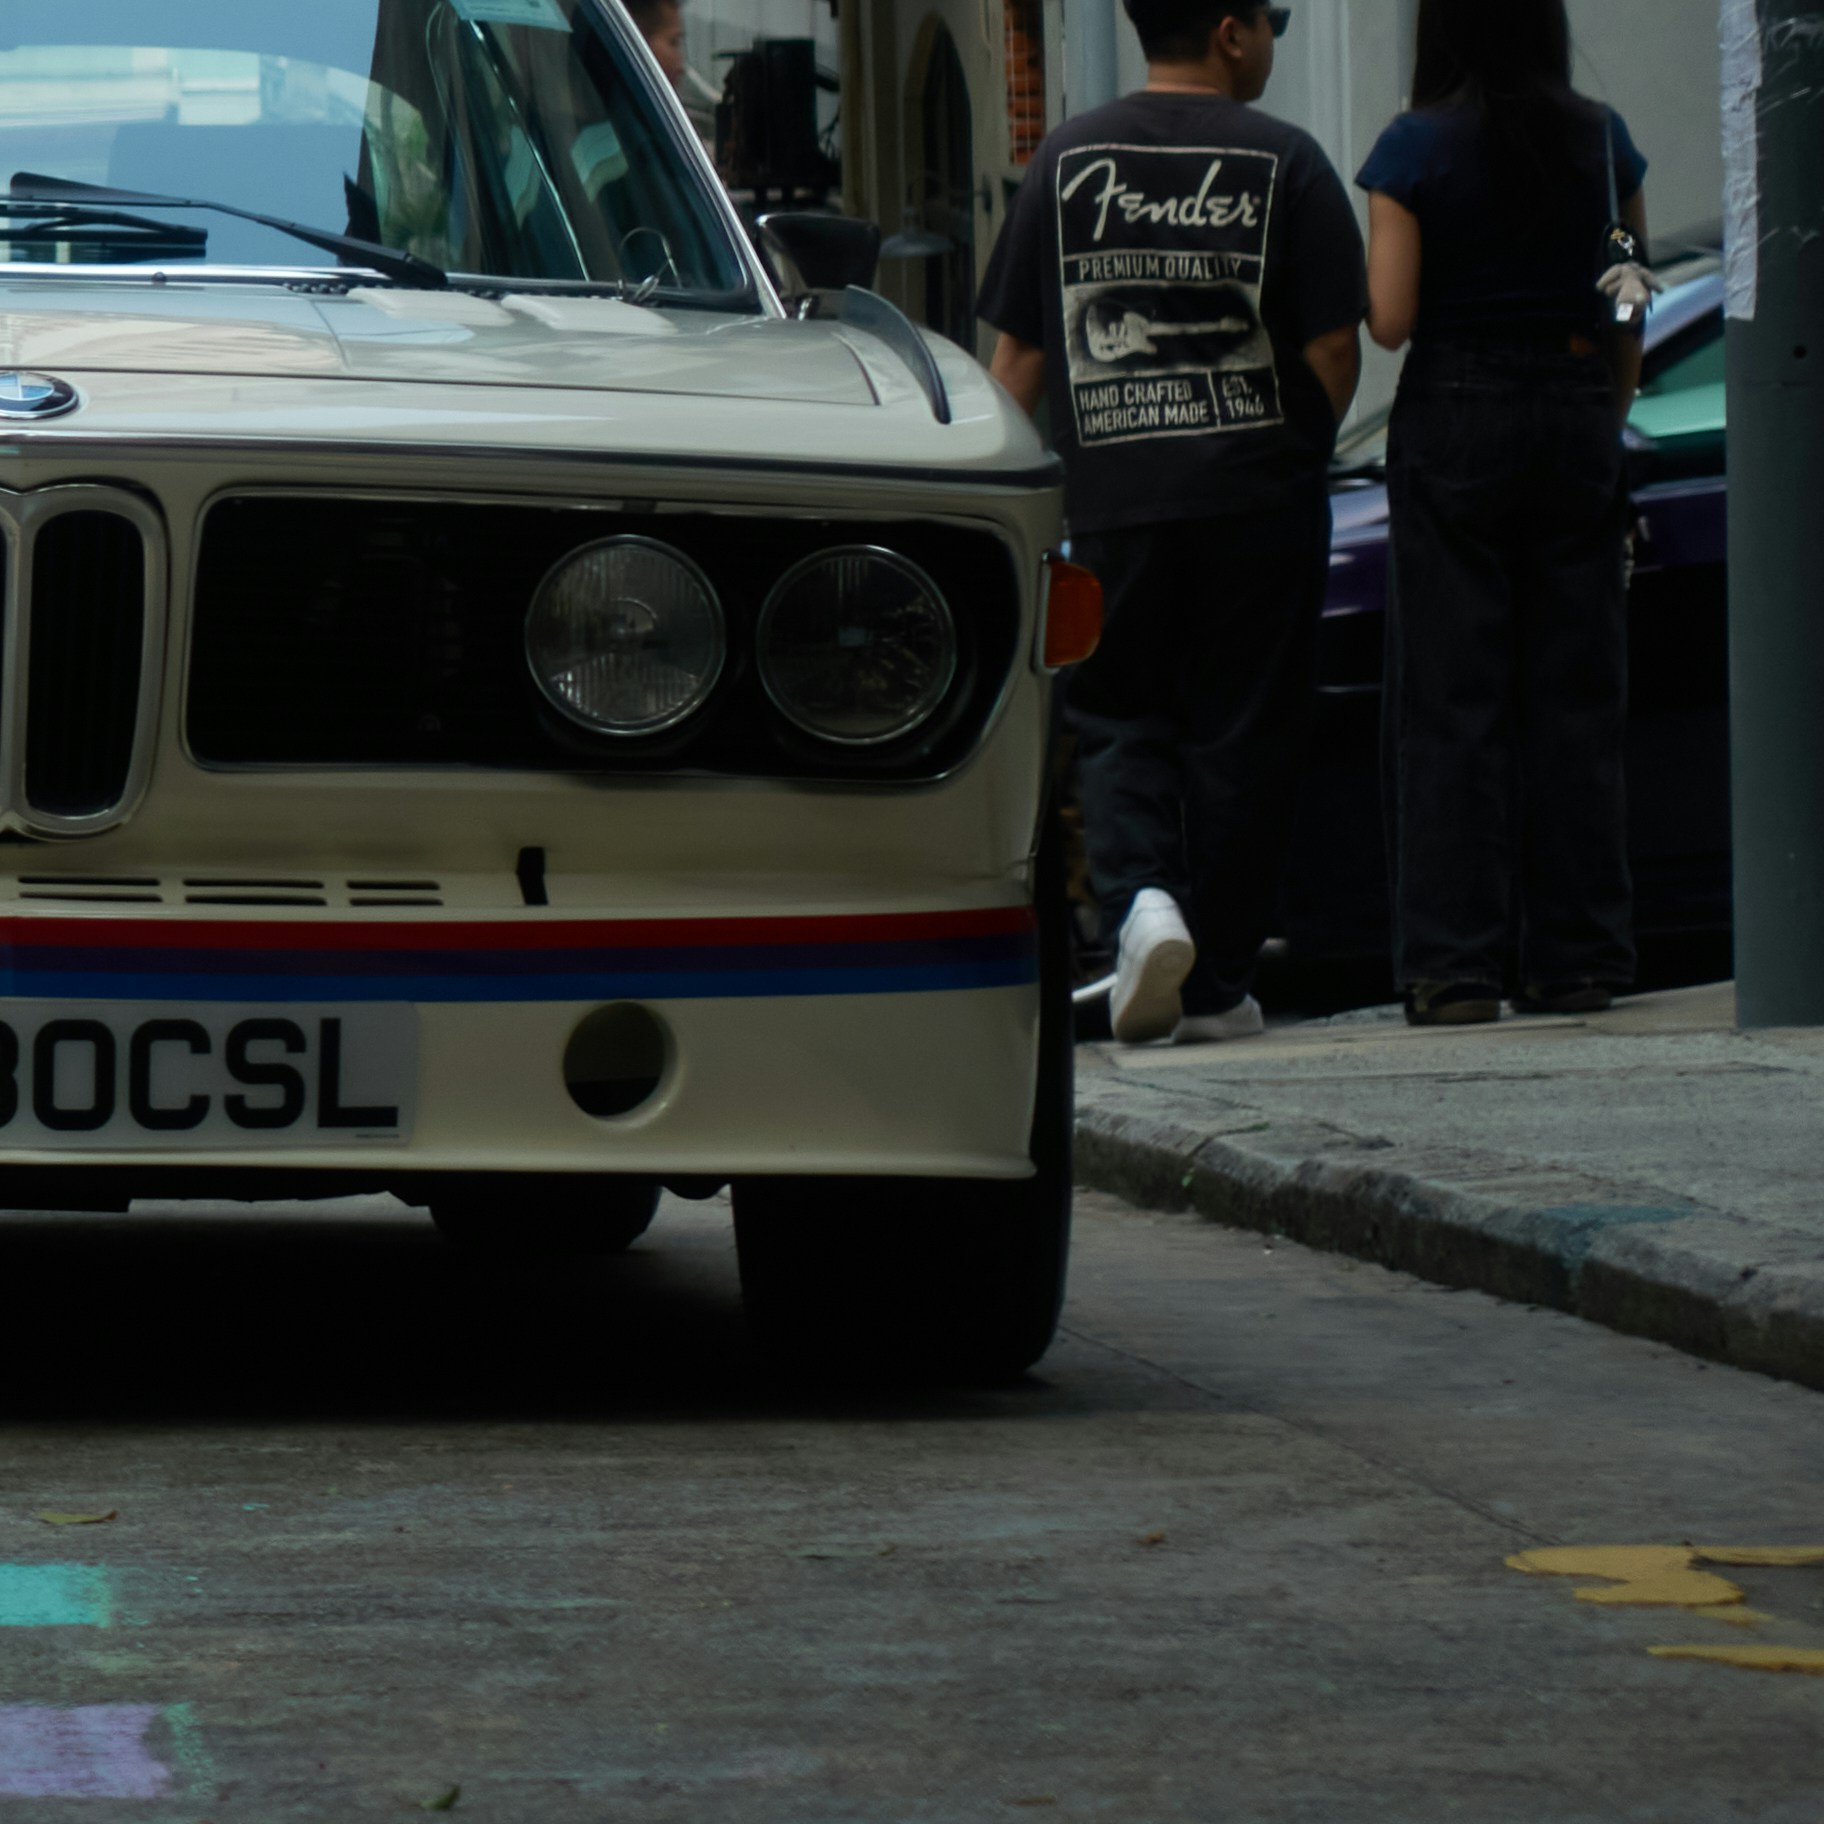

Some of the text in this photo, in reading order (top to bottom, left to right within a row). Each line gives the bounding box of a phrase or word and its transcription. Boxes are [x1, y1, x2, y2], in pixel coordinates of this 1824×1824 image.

[1061, 158, 1258, 241] Fender
[1078, 256, 1242, 281] PREMIUM QUALITY
[1079, 379, 1193, 412] HAND CRAFTED
[1225, 393, 1265, 420] 1946
[1084, 401, 1209, 435] AMERICAN MADE
